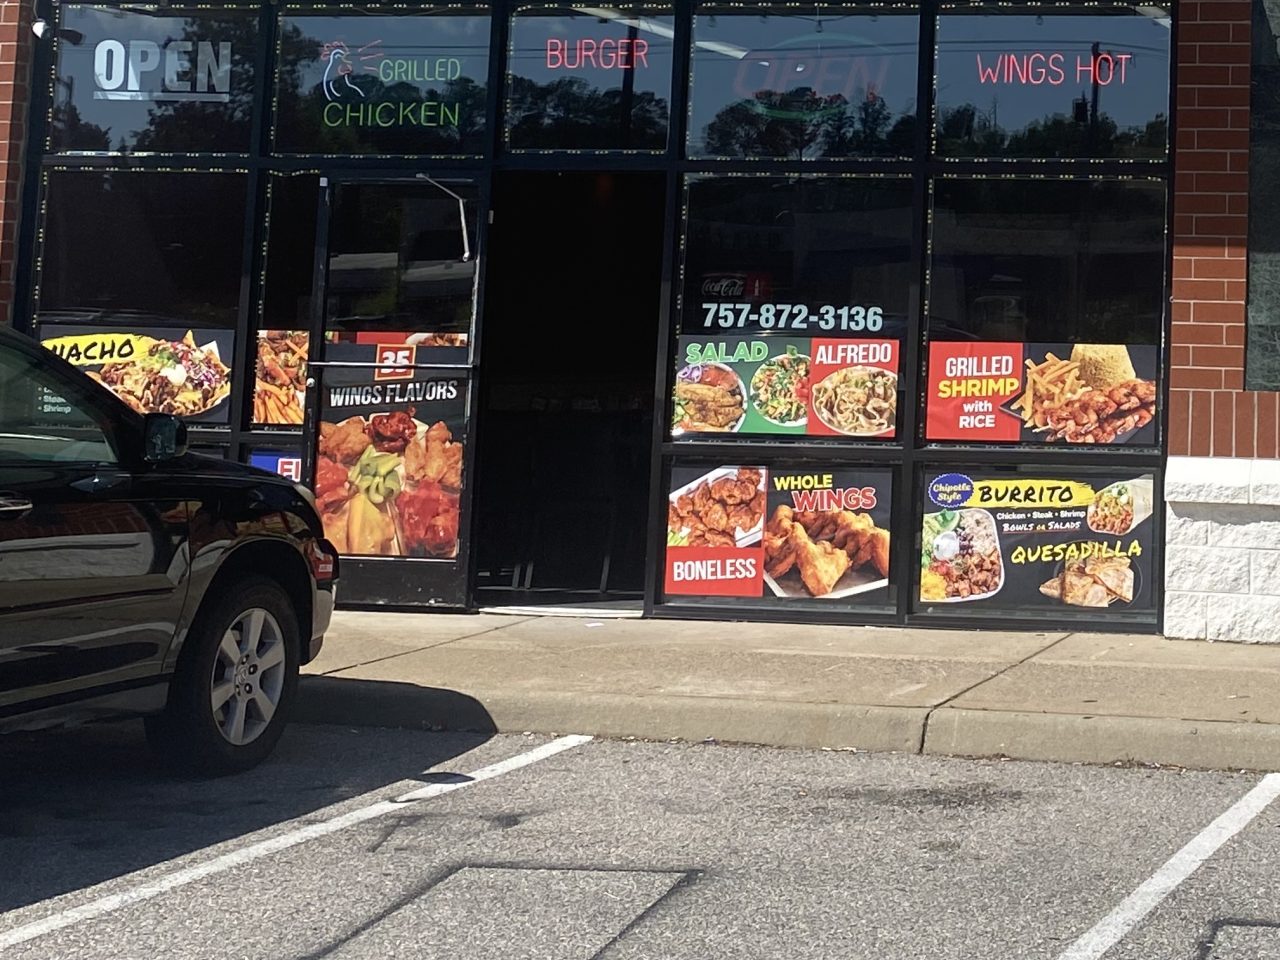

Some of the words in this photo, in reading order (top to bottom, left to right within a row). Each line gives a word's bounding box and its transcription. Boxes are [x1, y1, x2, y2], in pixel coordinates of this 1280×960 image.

[93, 39, 232, 93] OPEN
[546, 38, 649, 70] BURGER
[379, 57, 461, 81] GRILLED
[976, 53, 1065, 85] WINGS
[1076, 53, 1132, 85] HOT
[324, 101, 460, 127] CHICKEN
[701, 302, 884, 332] 757-872-3136
[685, 340, 769, 364] SALAD
[815, 343, 892, 365] ALFREDO
[945, 355, 1013, 378] GRILLED
[330, 385, 382, 407] WINGS
[385, 381, 458, 403] FLAVORS
[938, 377, 1019, 399] SHRIMP
[963, 400, 993, 413] with
[959, 415, 996, 428] RICE
[773, 474, 833, 491] WHOLE
[978, 485, 1074, 503] BURRITO
[790, 486, 877, 513] WINGS
[937, 493, 963, 504] Style
[996, 511, 1026, 520] Chicken
[1032, 511, 1054, 520] Steak
[1059, 510, 1086, 520] Shrimp
[1011, 539, 1143, 565] QUESADILLA
[673, 558, 757, 582] BONELESS
